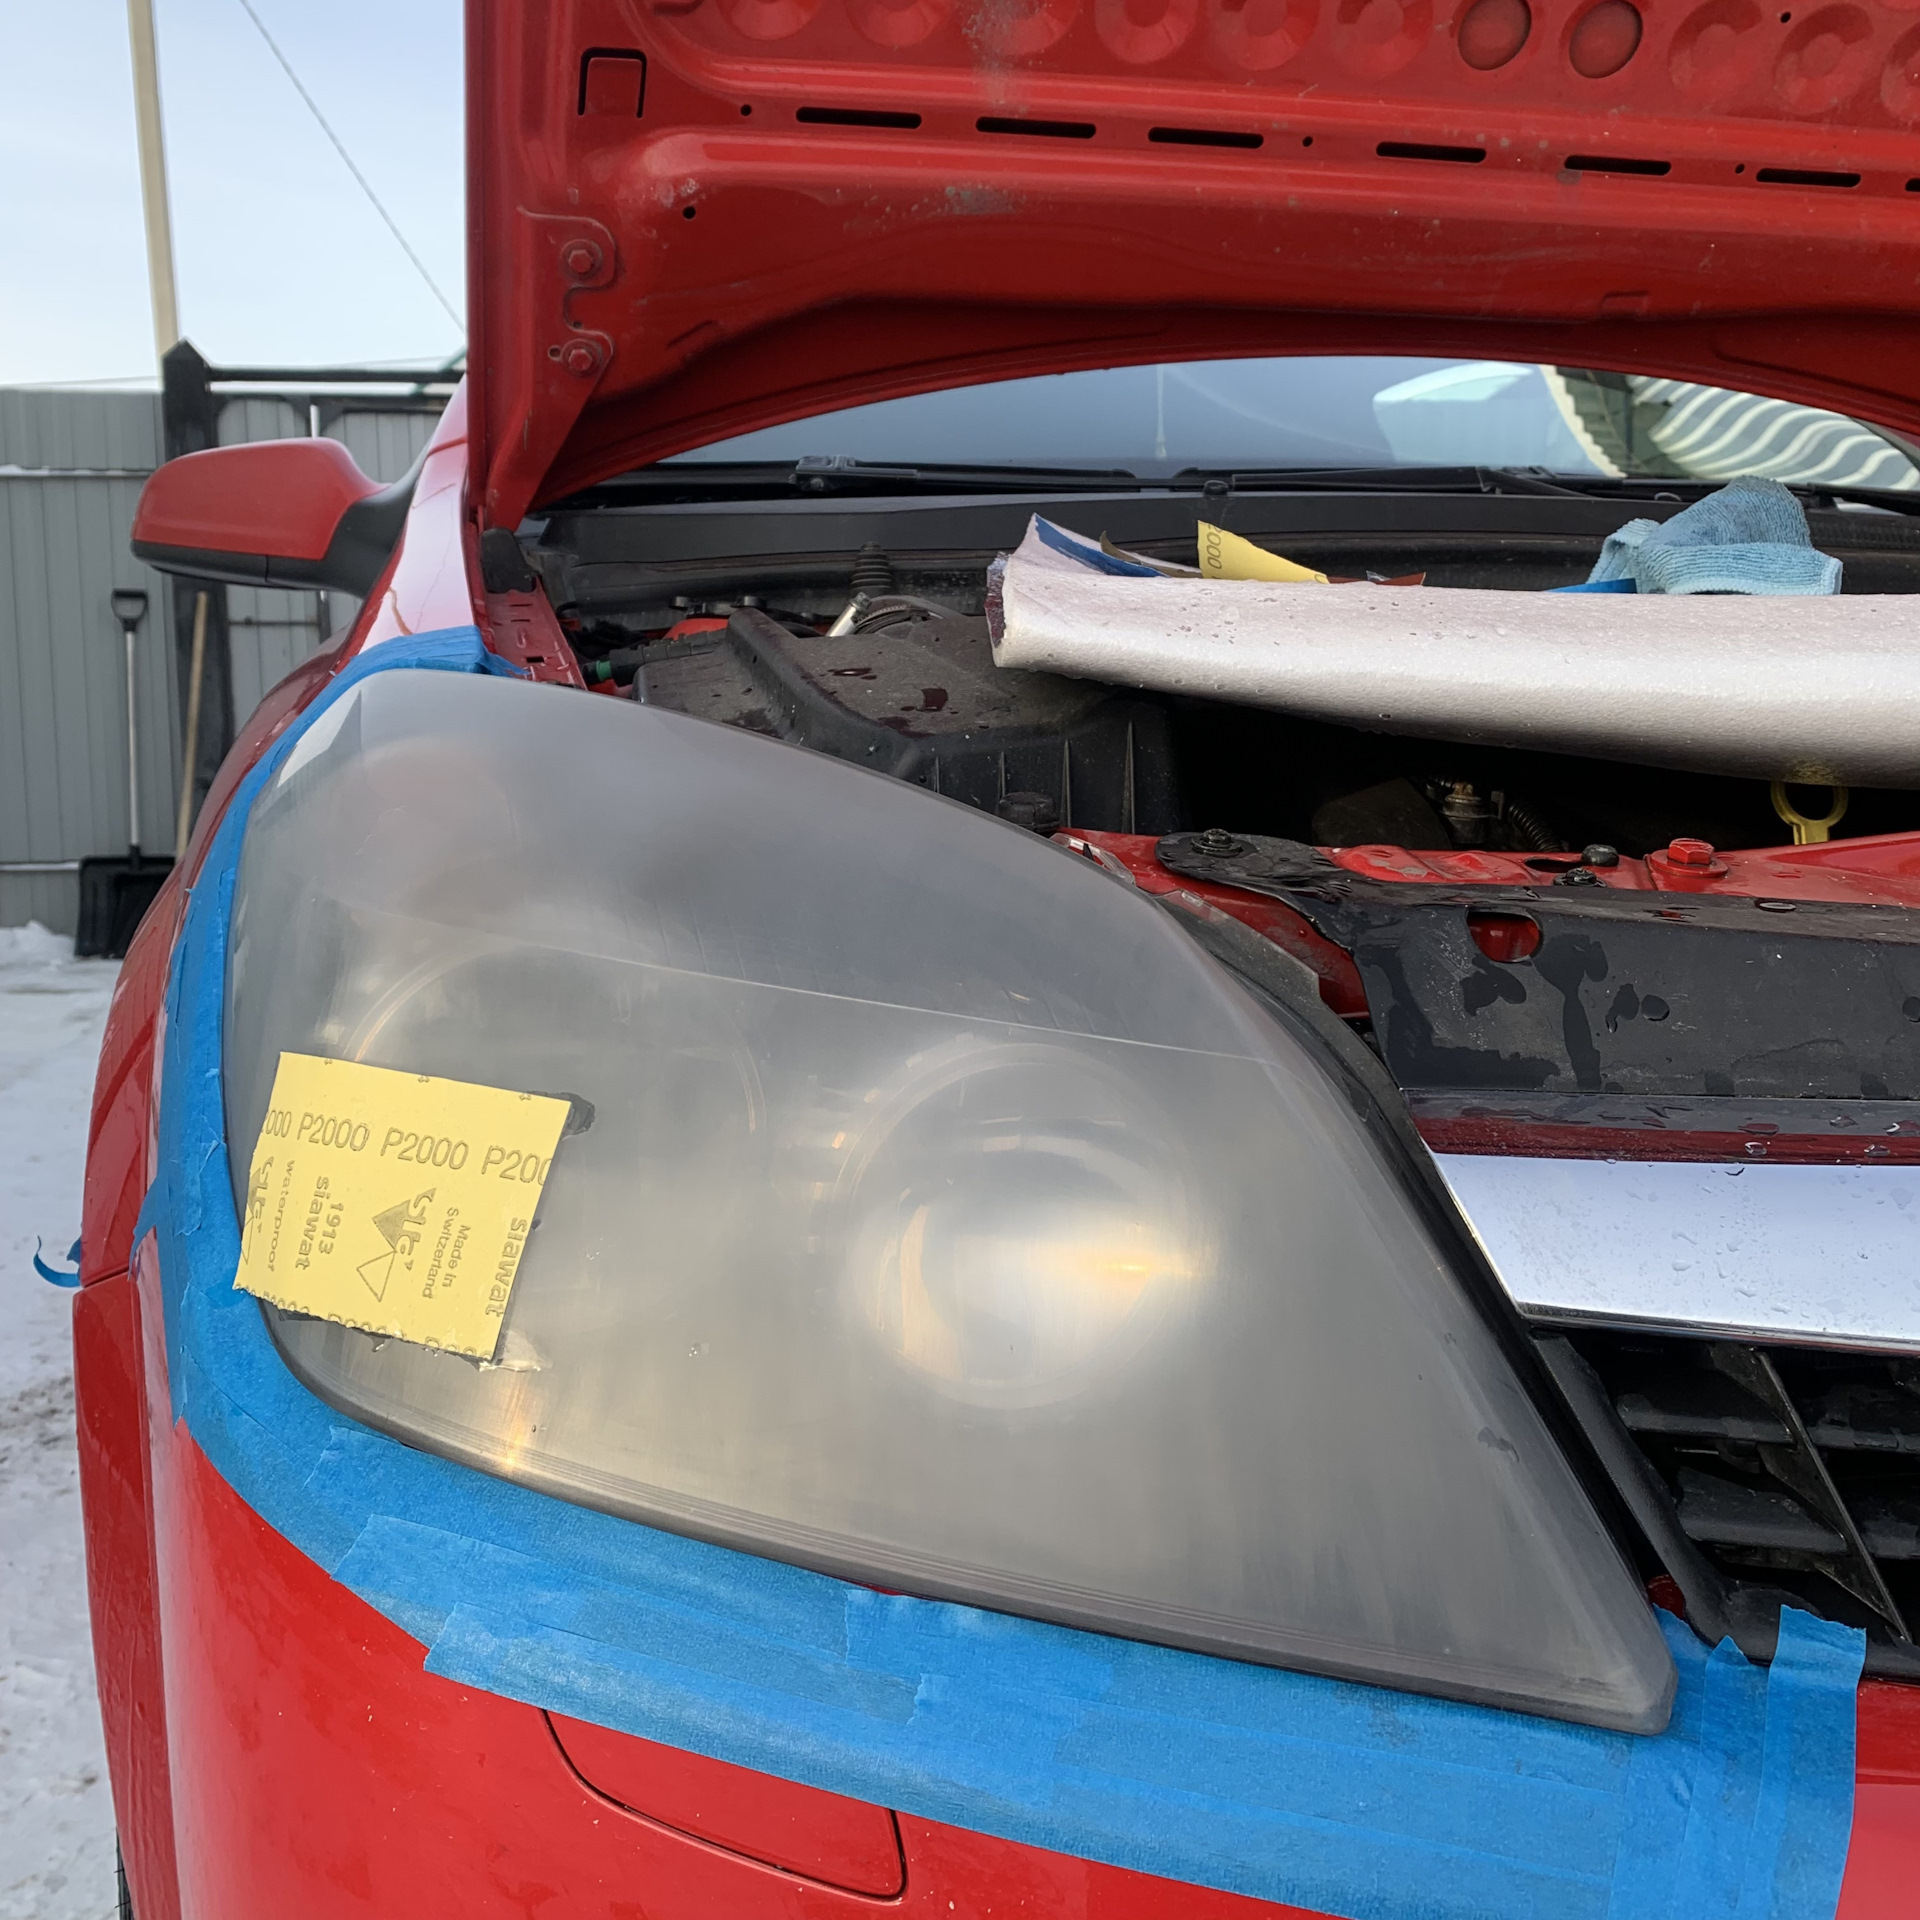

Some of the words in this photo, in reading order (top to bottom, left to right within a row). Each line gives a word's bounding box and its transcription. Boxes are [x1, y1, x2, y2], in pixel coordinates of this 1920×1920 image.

[261, 1109, 292, 1138] 000
[297, 1112, 370, 1151] P2000
[380, 1126, 469, 1170] P2000
[267, 1160, 295, 1272] waterproof
[295, 1175, 331, 1270] siawat
[318, 1202, 344, 1255] 1913
[422, 1206, 460, 1299] Switzerland
[450, 1224, 471, 1270] Made
[442, 1274, 456, 1288] in
